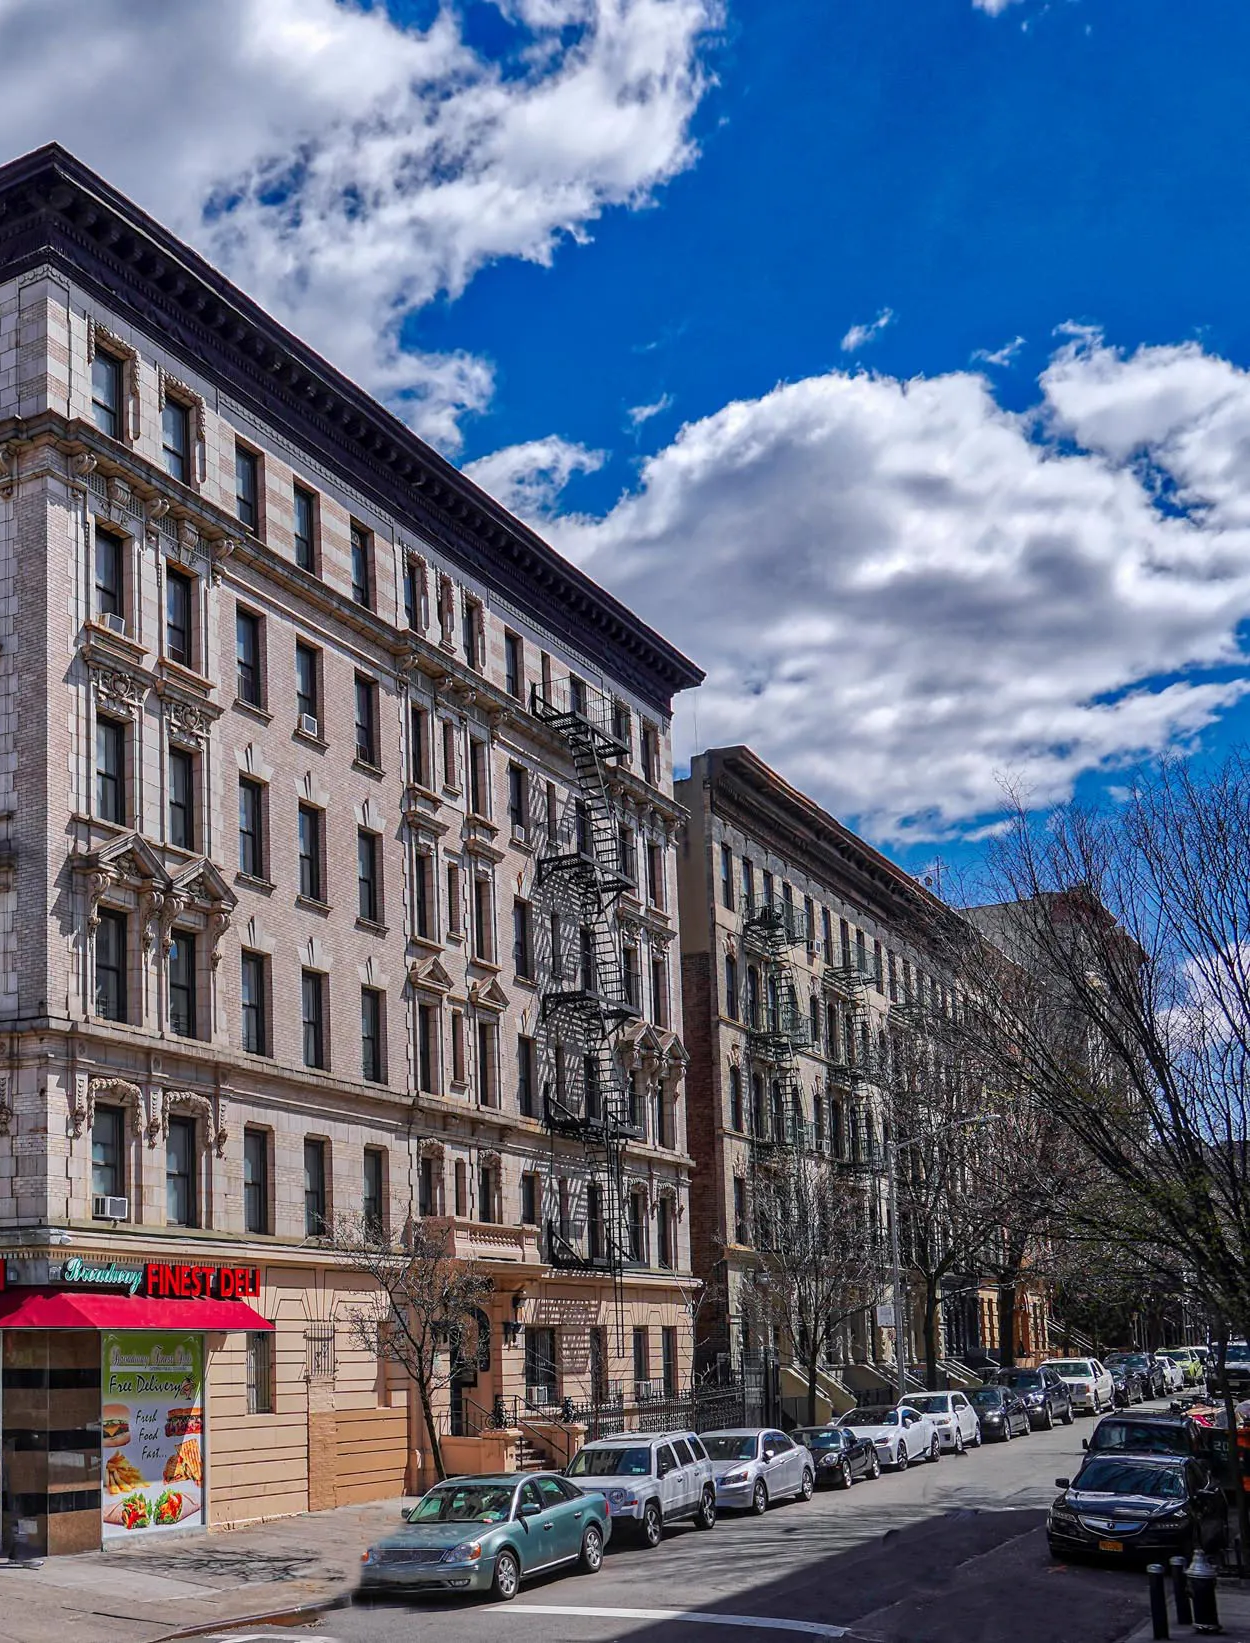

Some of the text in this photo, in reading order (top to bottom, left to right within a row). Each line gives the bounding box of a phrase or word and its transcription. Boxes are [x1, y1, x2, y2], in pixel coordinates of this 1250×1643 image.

[65, 1257, 260, 1297] Broadway FINEST DELI
[110, 1374, 182, 1398] Free Delivery
[135, 1409, 158, 1425] Fresh
[139, 1428, 159, 1442] Food
